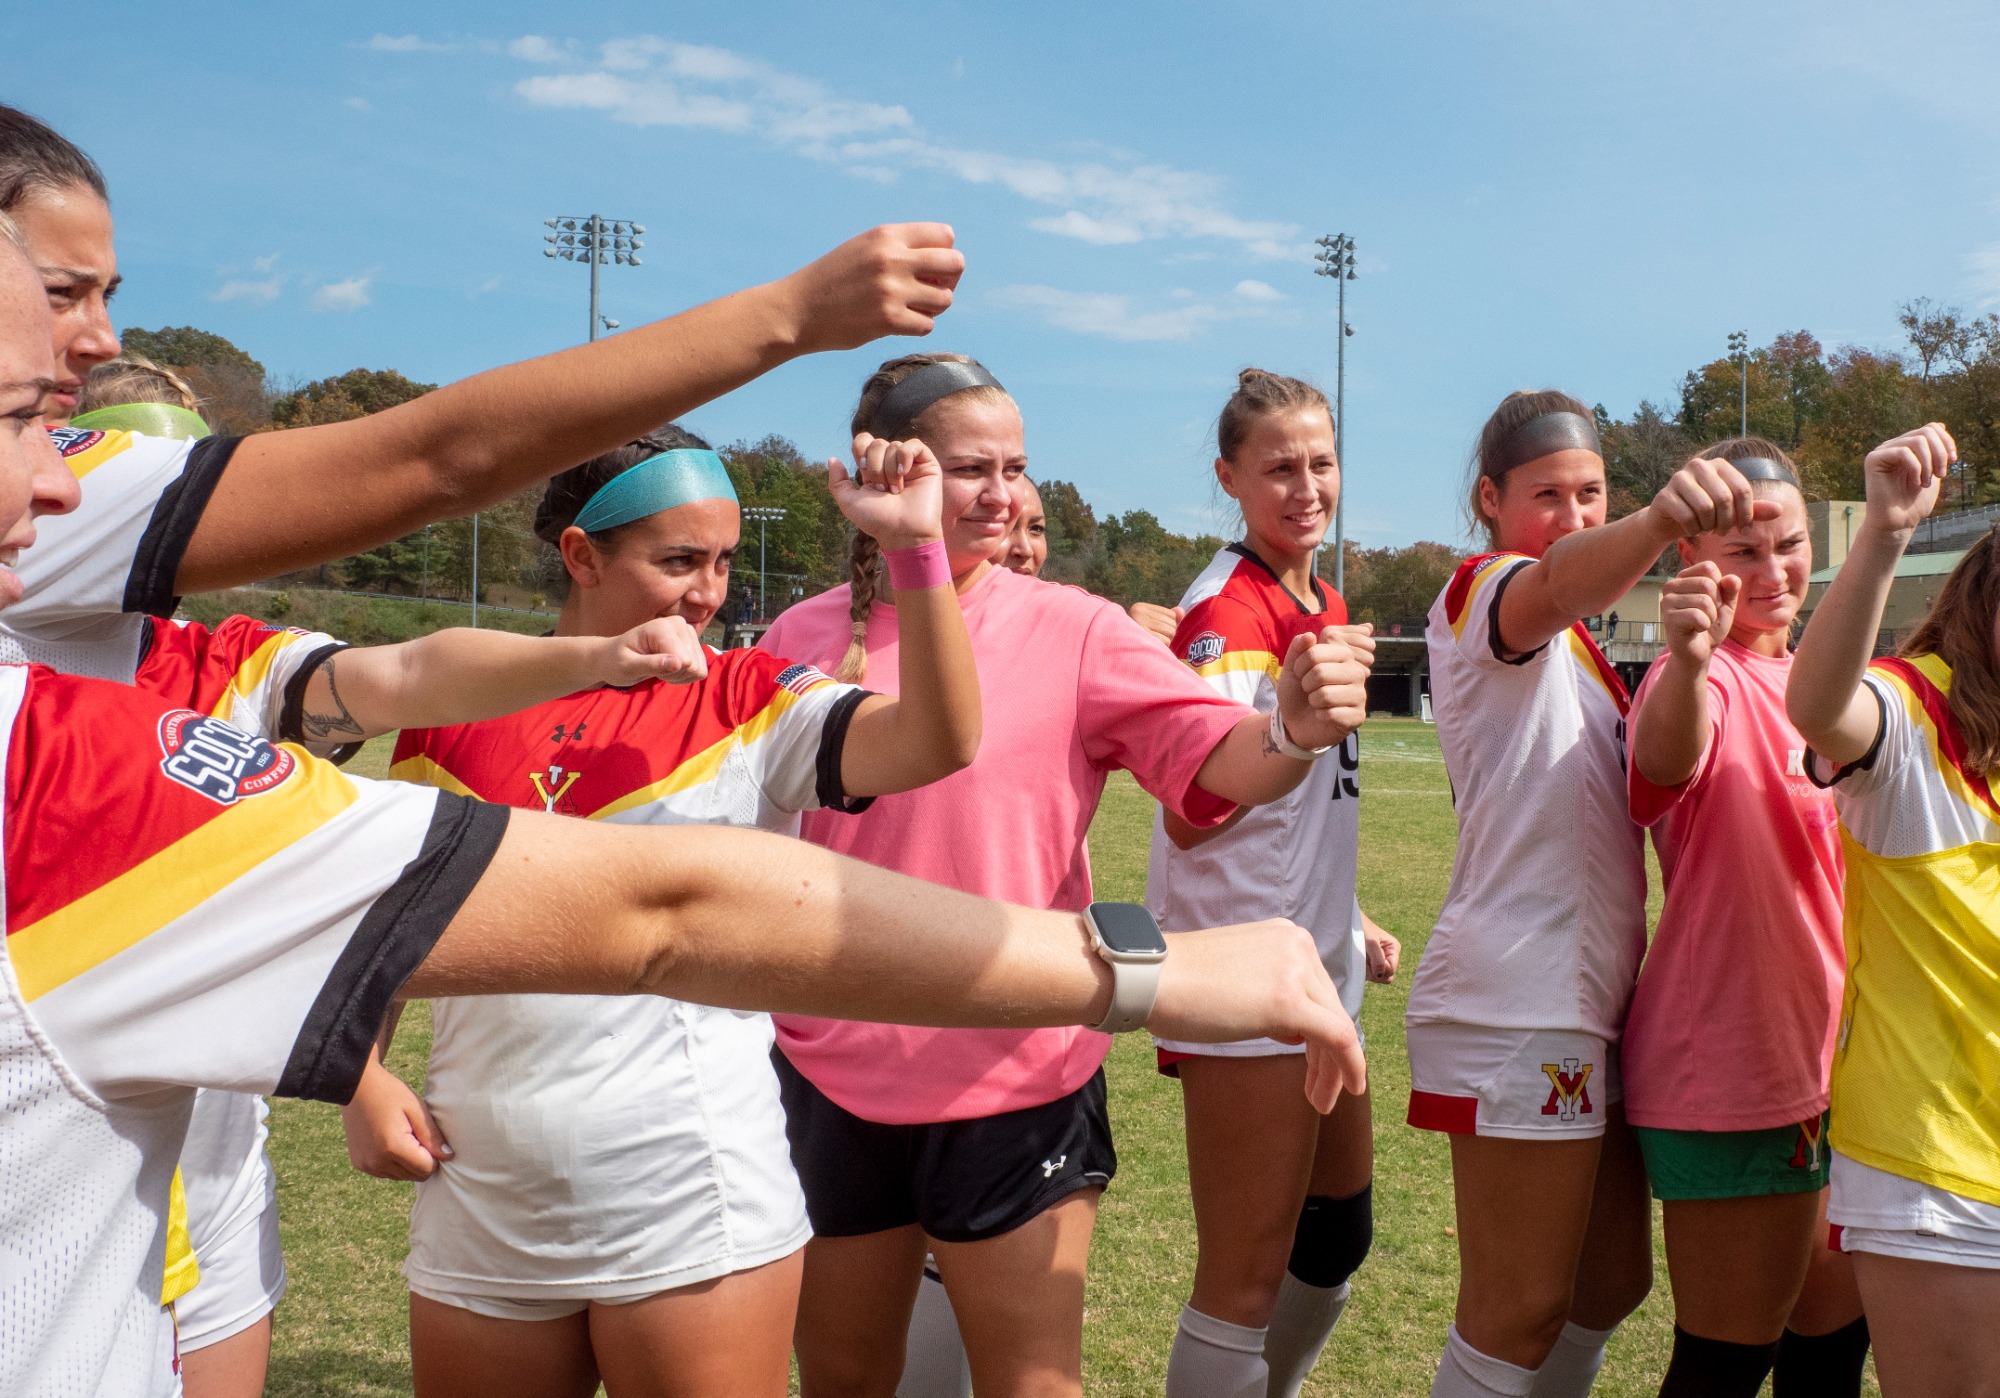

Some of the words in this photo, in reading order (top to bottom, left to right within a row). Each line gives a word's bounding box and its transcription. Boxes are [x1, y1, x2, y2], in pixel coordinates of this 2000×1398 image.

[1189, 638, 1225, 662] SOCON
[167, 718, 257, 799] SOCO
[256, 751, 270, 767] 1921
